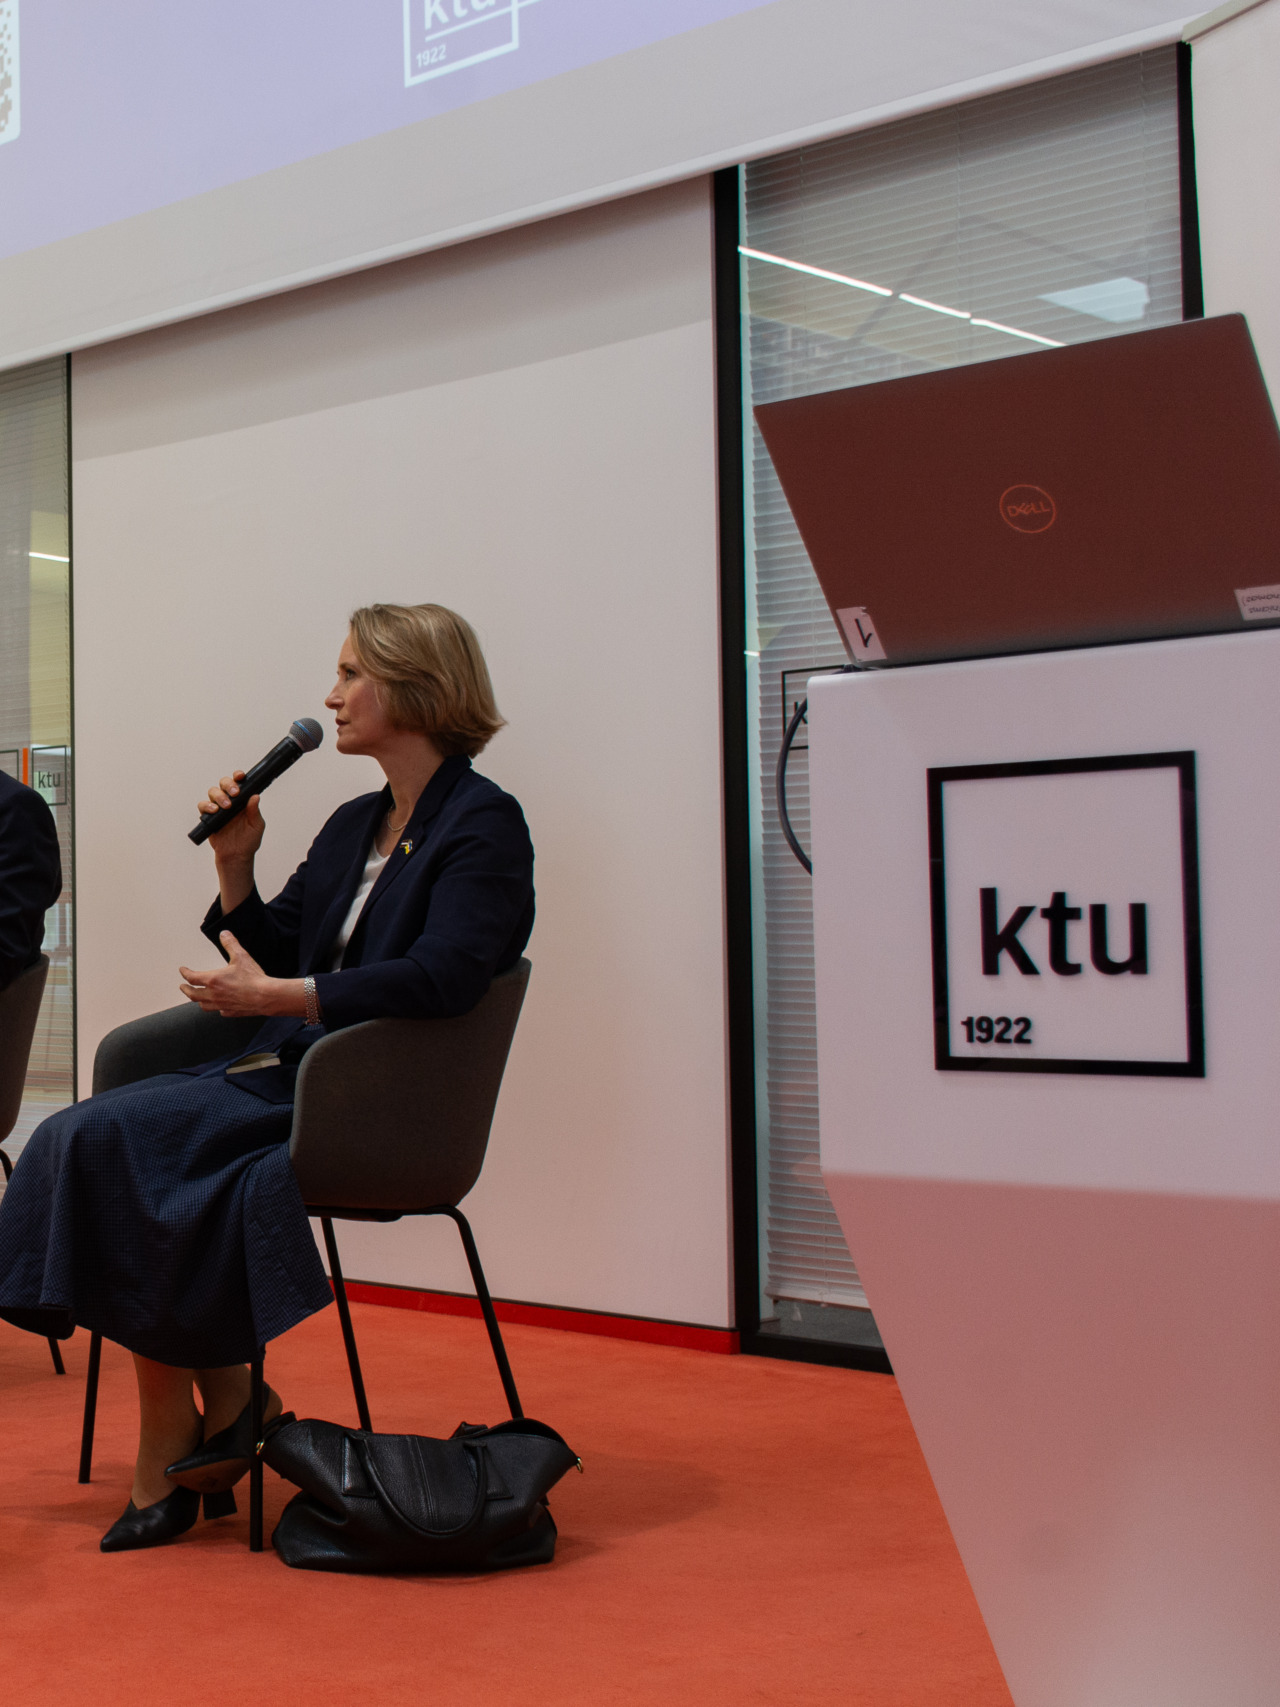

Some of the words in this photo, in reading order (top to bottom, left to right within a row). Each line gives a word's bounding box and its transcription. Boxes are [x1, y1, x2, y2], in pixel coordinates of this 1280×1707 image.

[416, 44, 447, 68] 1922
[1007, 501, 1050, 517] DELL
[38, 771, 61, 788] ktu
[979, 887, 1148, 976] ktu
[961, 1016, 1032, 1044] 1922
